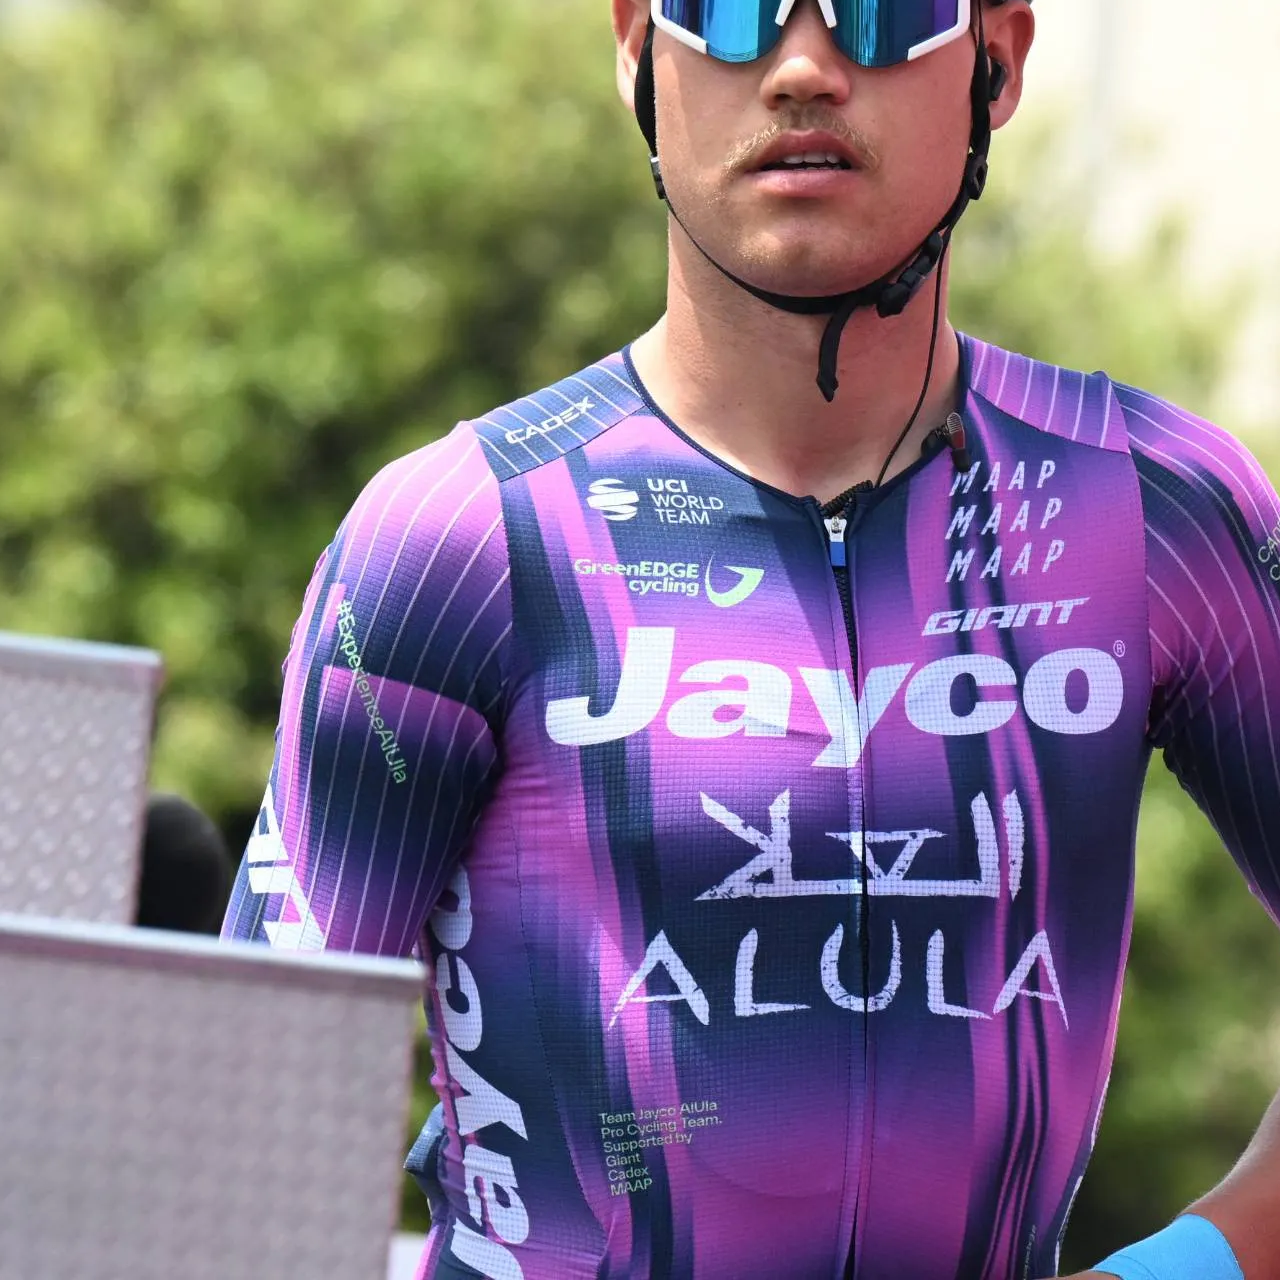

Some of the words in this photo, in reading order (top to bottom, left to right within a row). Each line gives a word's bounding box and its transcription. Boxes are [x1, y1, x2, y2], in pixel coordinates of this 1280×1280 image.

[504, 396, 596, 445] CADEX
[647, 478, 688, 492] UCI
[949, 460, 1057, 497] MAAP
[650, 493, 724, 510] WORLD
[655, 509, 710, 525] TEAM
[945, 497, 1063, 540] MAAP
[574, 558, 700, 578] GreenEDGE
[945, 539, 1065, 583] MAAP
[628, 577, 700, 597] cycling
[921, 597, 1091, 636] GIANT
[545, 627, 1124, 768] Jayco
[607, 920, 1069, 1032] ALULA
[598, 1112, 636, 1125] Team
[639, 1107, 677, 1120] Jayco
[680, 1100, 718, 1115] AlUla
[601, 1127, 625, 1140] Pro
[627, 1120, 677, 1136] Cycling
[681, 1115, 723, 1128] Team.
[603, 1134, 674, 1153] Supported
[675, 1132, 693, 1144] by
[606, 1153, 641, 1167] Giant
[608, 1166, 649, 1181] Cadex
[610, 1178, 653, 1197] MAAP
